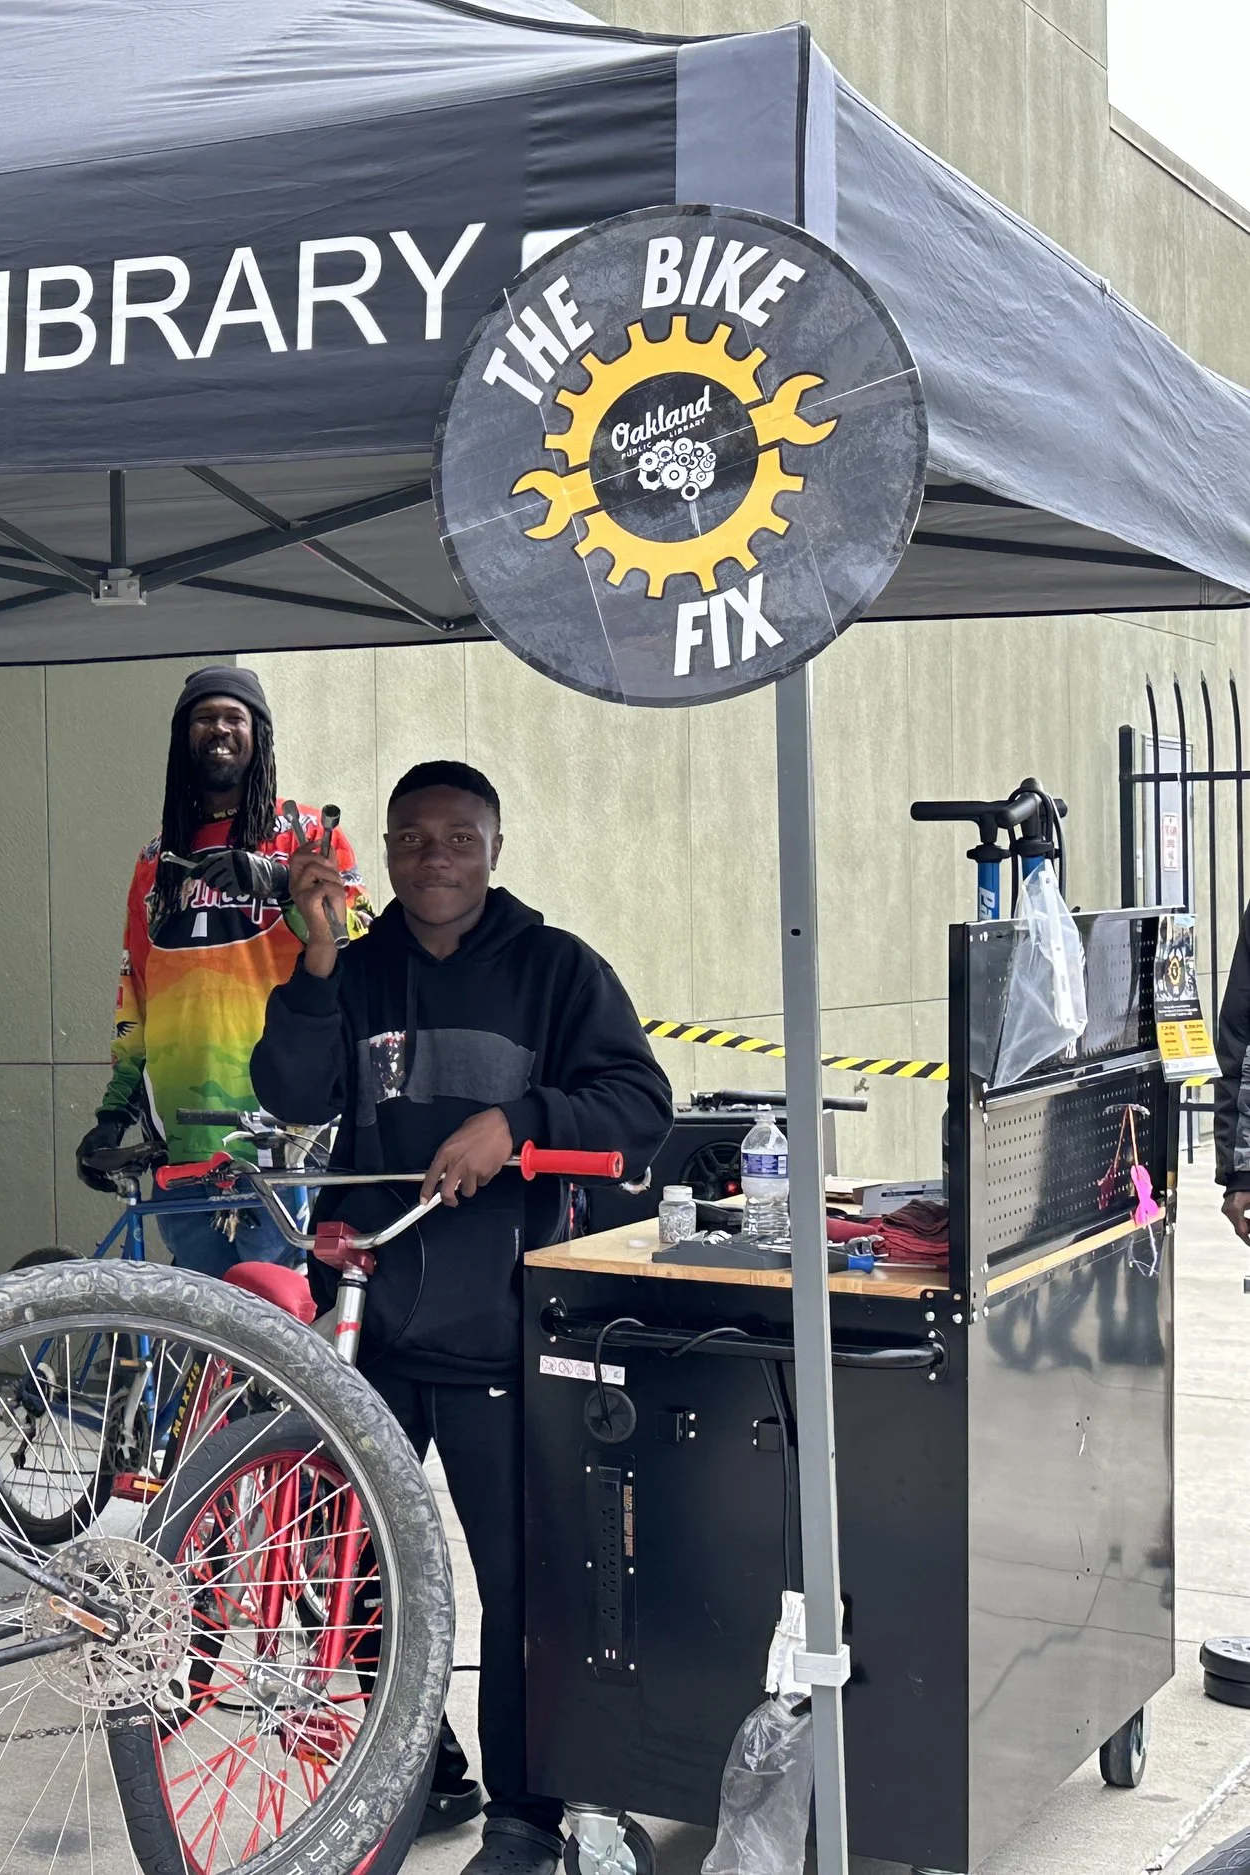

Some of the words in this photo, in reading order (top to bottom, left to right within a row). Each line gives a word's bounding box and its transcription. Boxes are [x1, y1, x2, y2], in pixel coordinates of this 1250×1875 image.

[482, 275, 594, 405] THE
[641, 236, 805, 327] BIKE
[611, 385, 713, 452] Oakland
[621, 441, 652, 460] PUBLIC
[669, 417, 706, 438] LIBRARY
[673, 573, 784, 676] FIX
